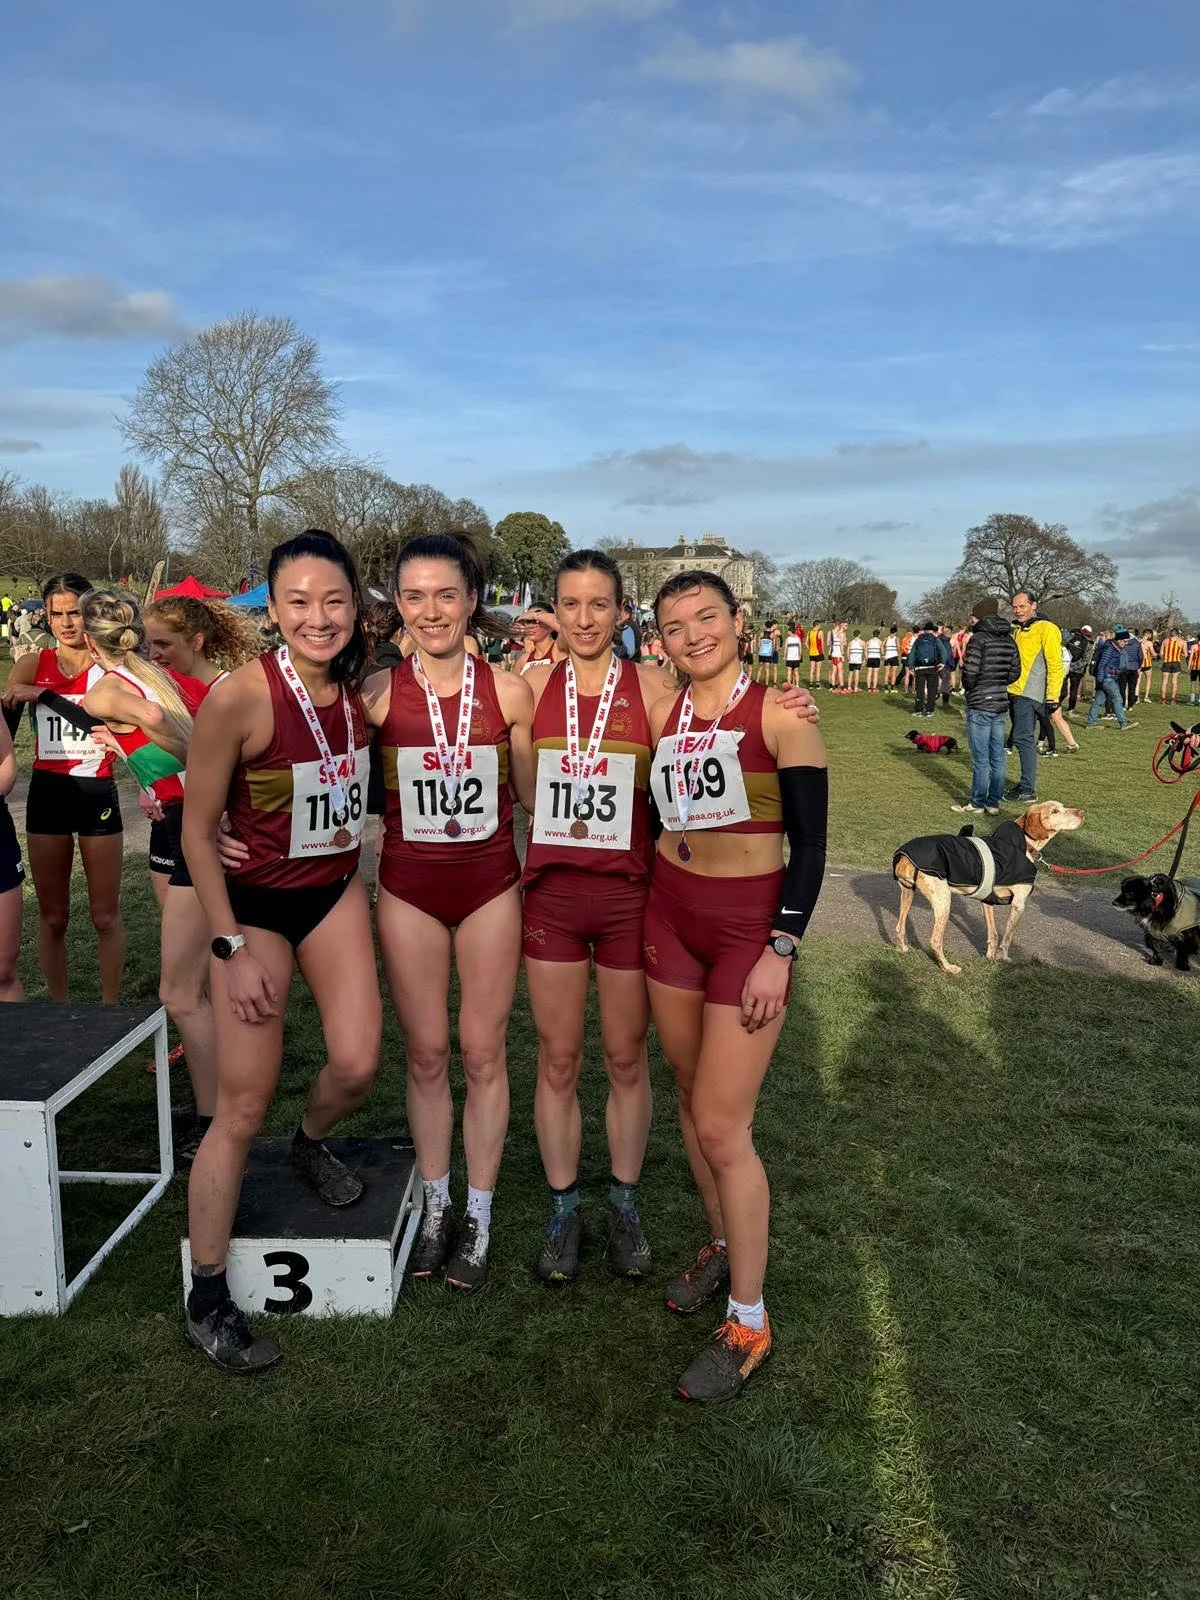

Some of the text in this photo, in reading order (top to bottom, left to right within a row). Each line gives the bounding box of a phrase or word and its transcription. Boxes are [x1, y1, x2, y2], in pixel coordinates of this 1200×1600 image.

[423, 752, 472, 770] SA
[561, 754, 608, 776] SA
[662, 758, 725, 803] 169
[412, 778, 484, 816] 1182
[550, 782, 616, 822] 1183
[667, 808, 735, 823] wweaa.org.uk
[413, 824, 488, 835] www.seorg.uk
[545, 830, 618, 842] www.s.org.uk
[262, 1250, 313, 1314] 3
